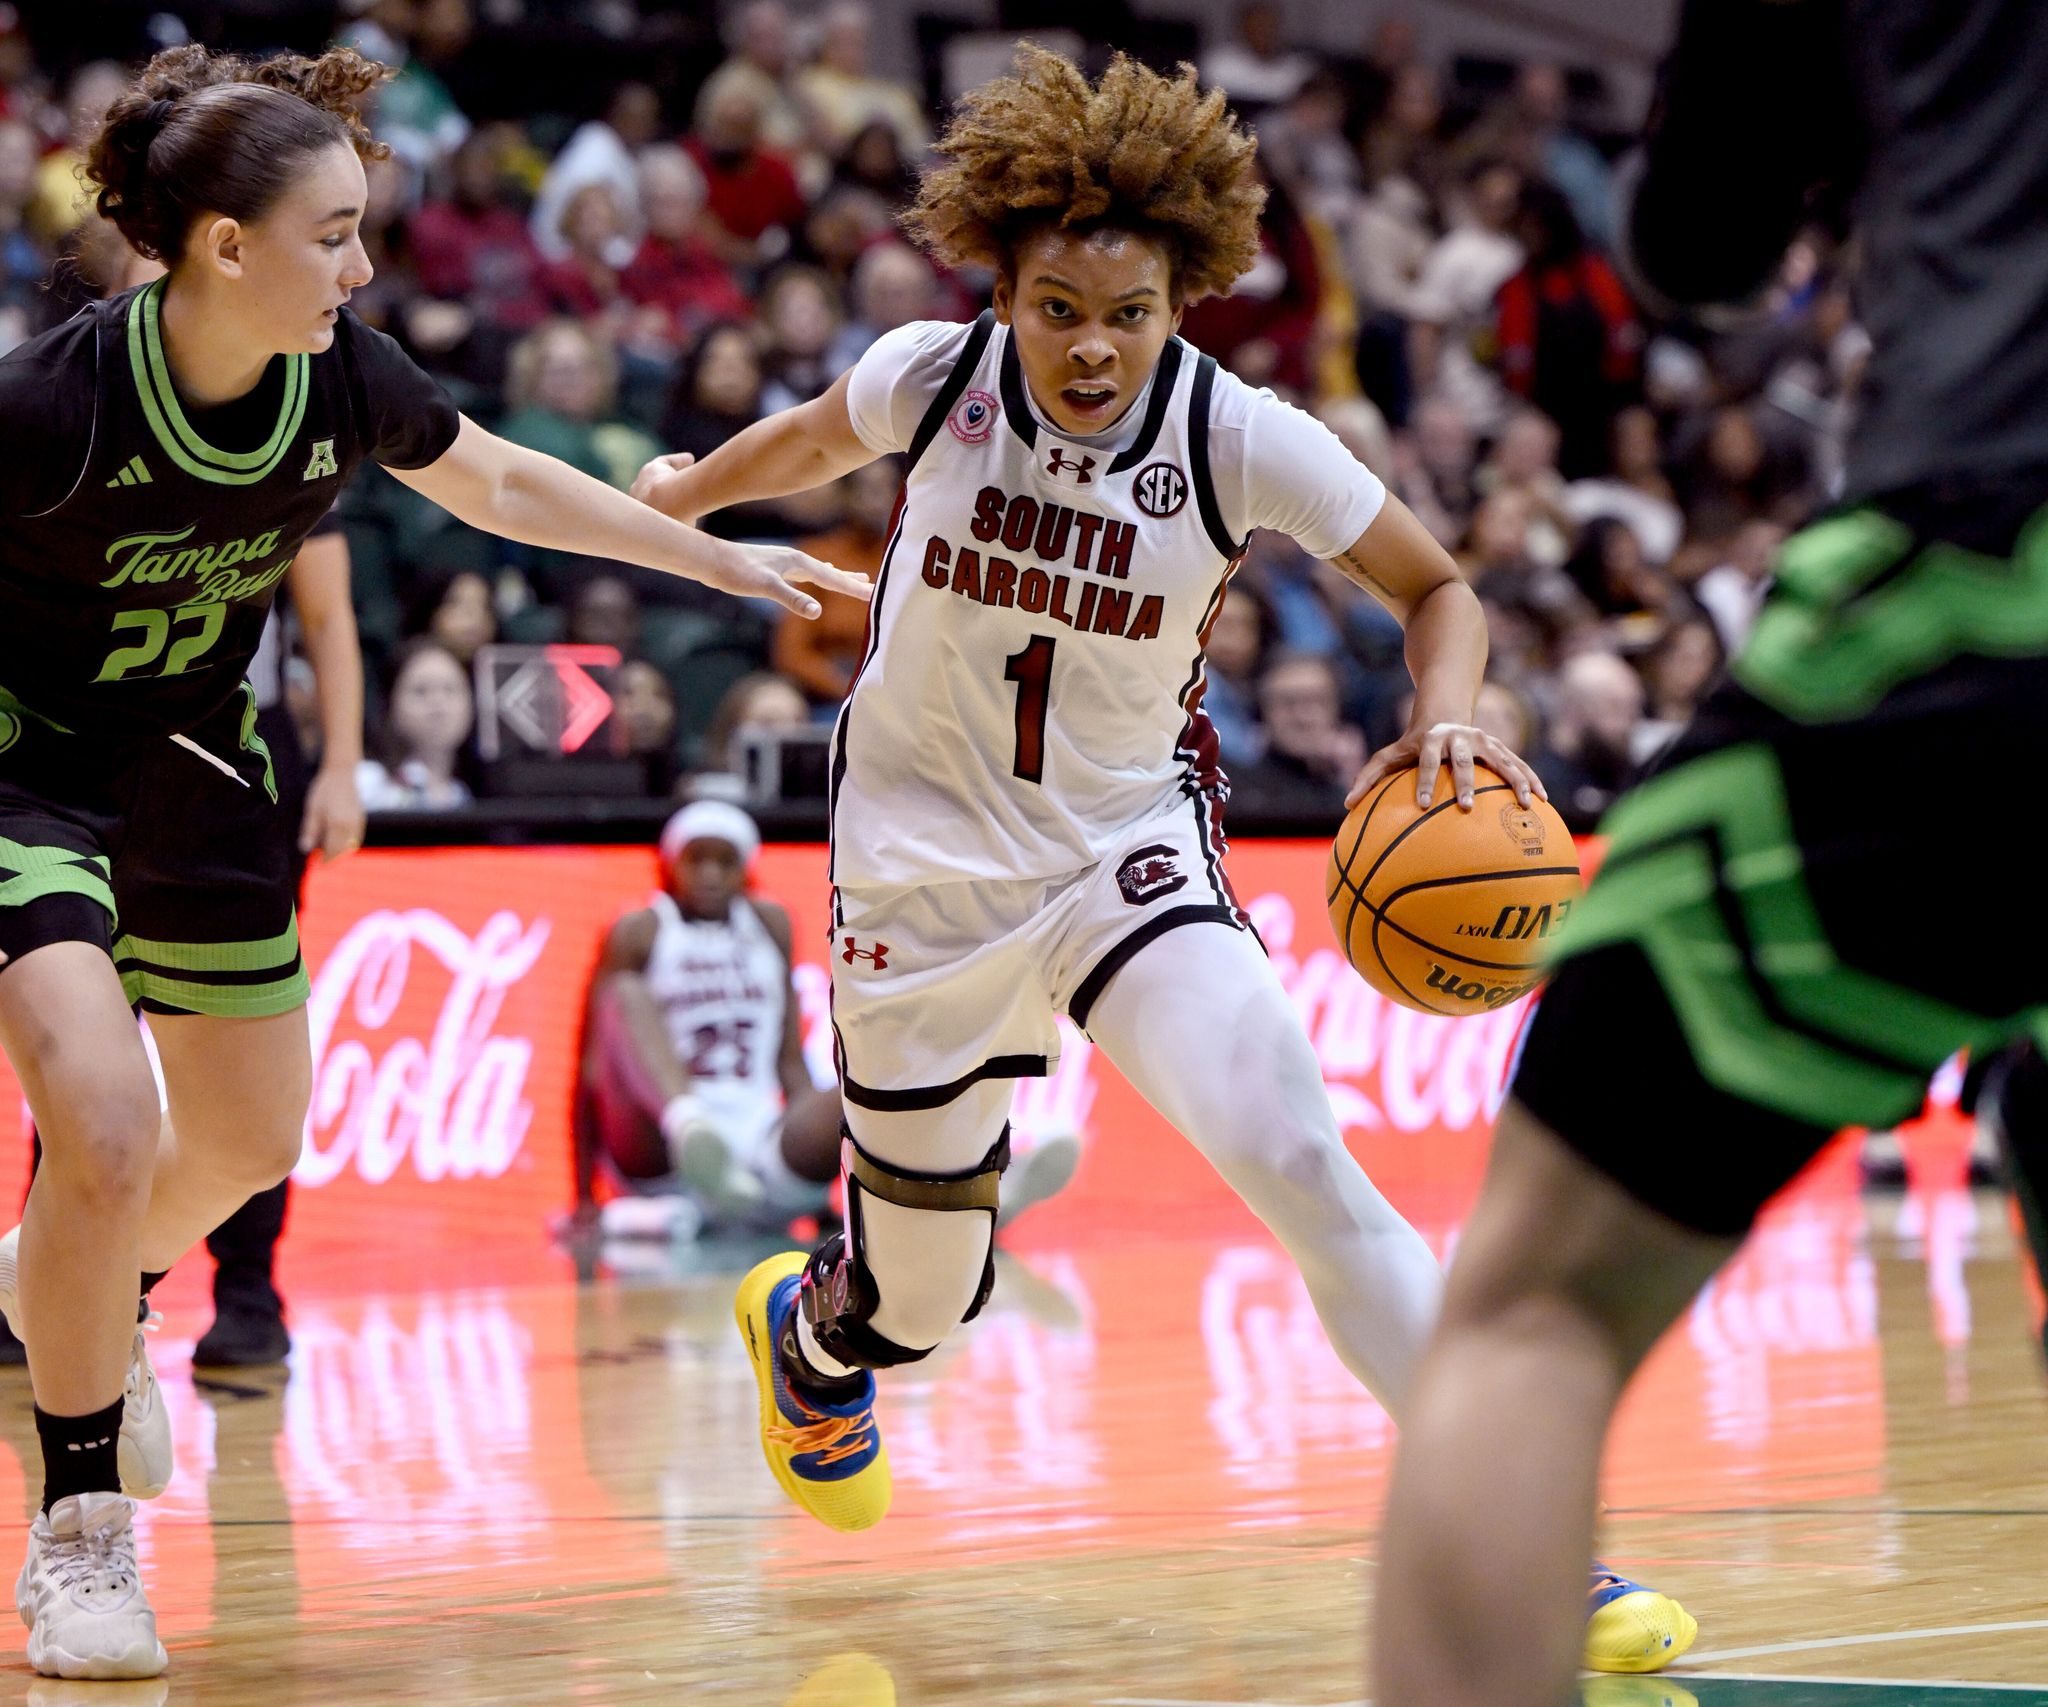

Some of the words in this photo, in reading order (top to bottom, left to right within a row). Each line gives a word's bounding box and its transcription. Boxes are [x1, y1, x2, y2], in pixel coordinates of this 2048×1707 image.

[1138, 466, 1184, 513] SEC
[99, 522, 284, 588] Tampa
[970, 486, 1138, 579] SOUTH
[168, 559, 293, 609] Bay
[921, 535, 1165, 641] CAROLINA
[89, 602, 227, 683] 22
[1004, 633, 1057, 785] 1
[1453, 923, 1490, 938] NXT
